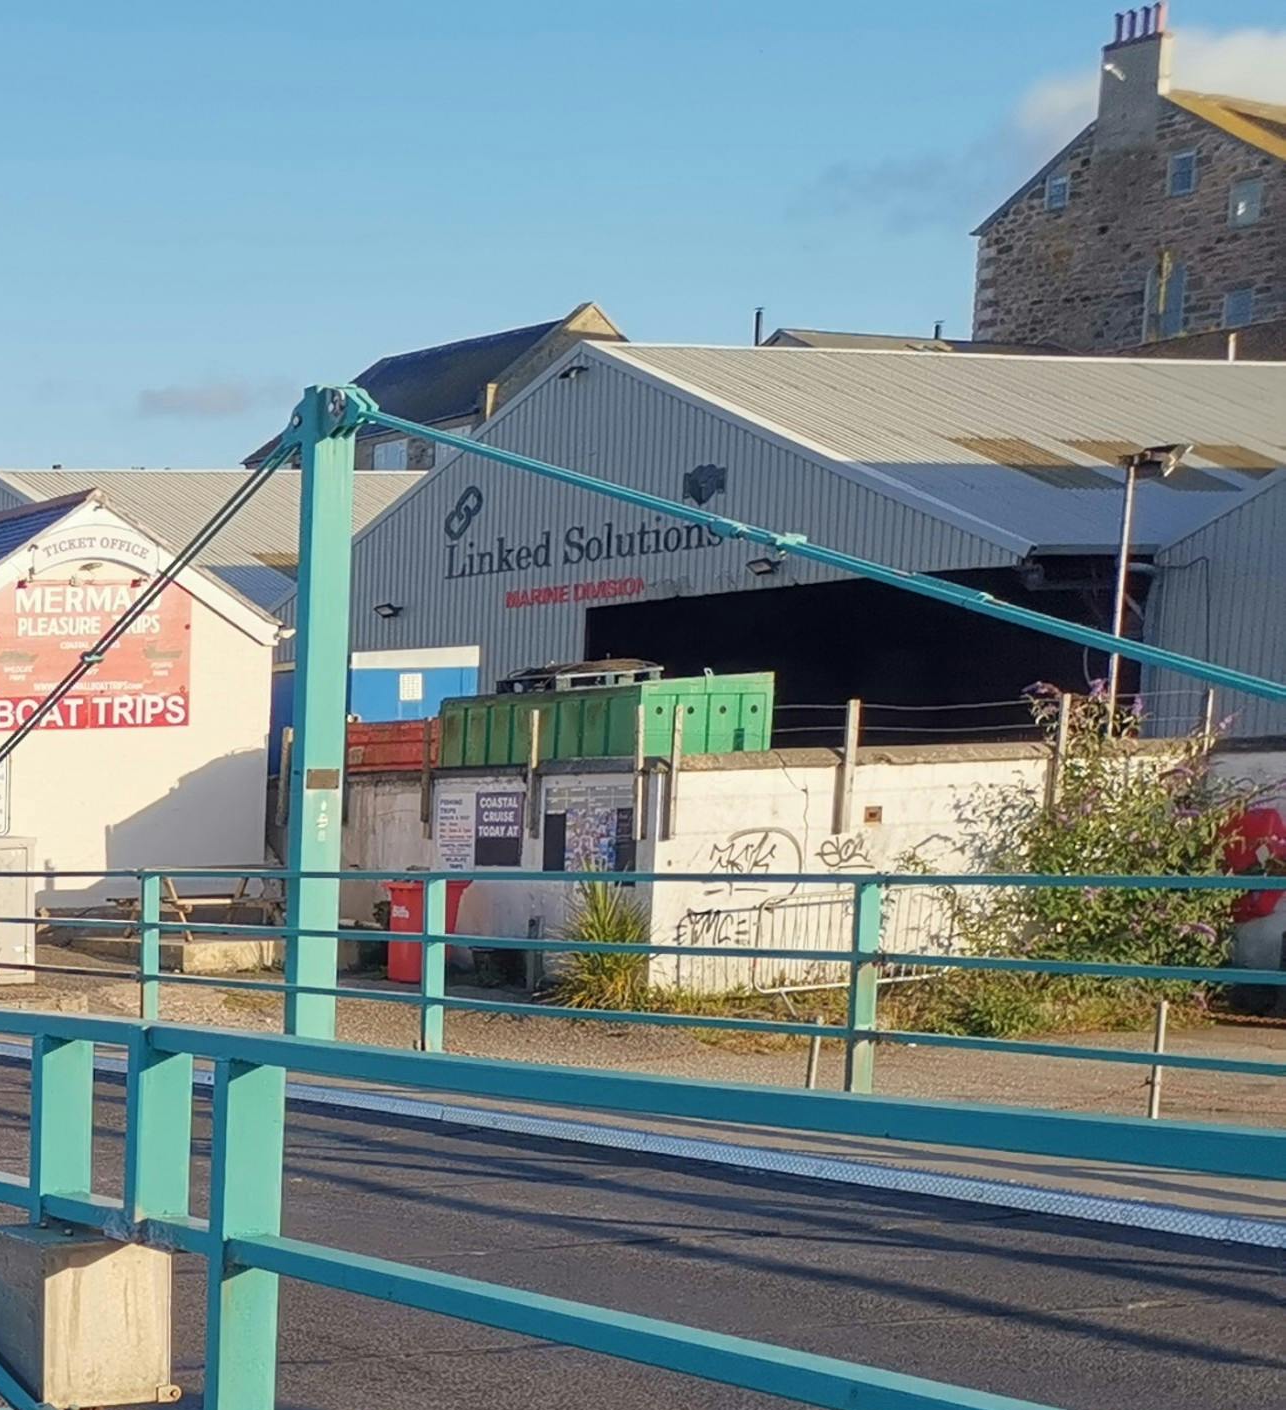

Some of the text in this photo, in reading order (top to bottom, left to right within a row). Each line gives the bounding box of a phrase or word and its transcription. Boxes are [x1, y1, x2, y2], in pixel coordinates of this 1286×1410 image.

[43, 537, 150, 560] TICKET OFFICE
[444, 515, 724, 579] Linked Solutions
[506, 585, 569, 608] MARINE
[16, 616, 102, 637] PLEASURE
[92, 694, 186, 726] TRIPS
[480, 797, 518, 808] COASTAL
[483, 811, 515, 822] CRUISE
[479, 826, 505, 836] TODAY
[507, 825, 519, 836] AT
